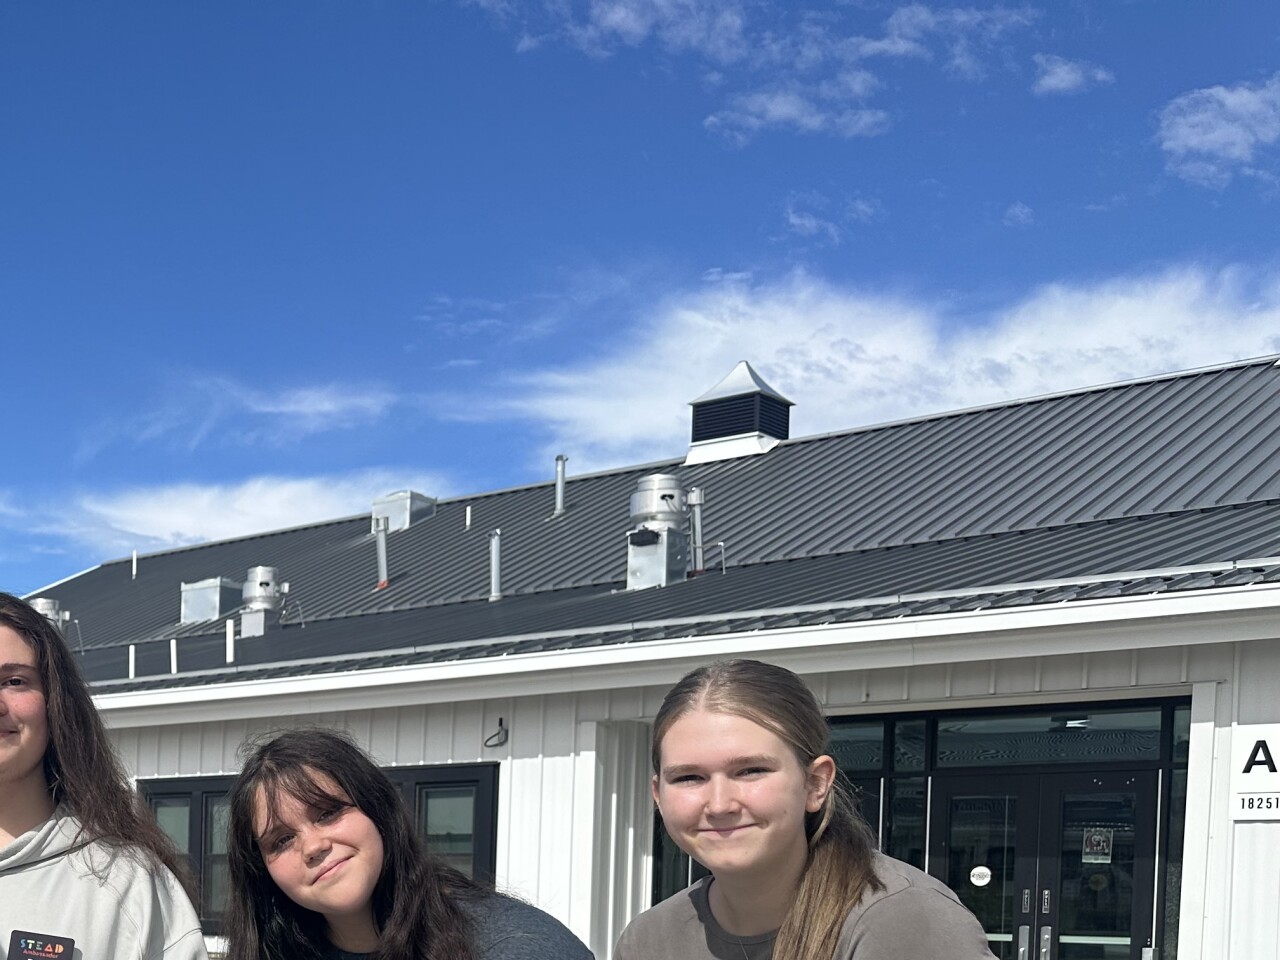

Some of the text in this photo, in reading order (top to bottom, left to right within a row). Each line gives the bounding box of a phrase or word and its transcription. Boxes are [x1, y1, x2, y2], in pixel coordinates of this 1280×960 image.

[1242, 740, 1278, 774] A
[1241, 797, 1280, 810] 18251
[20, 938, 64, 954] STEAD
